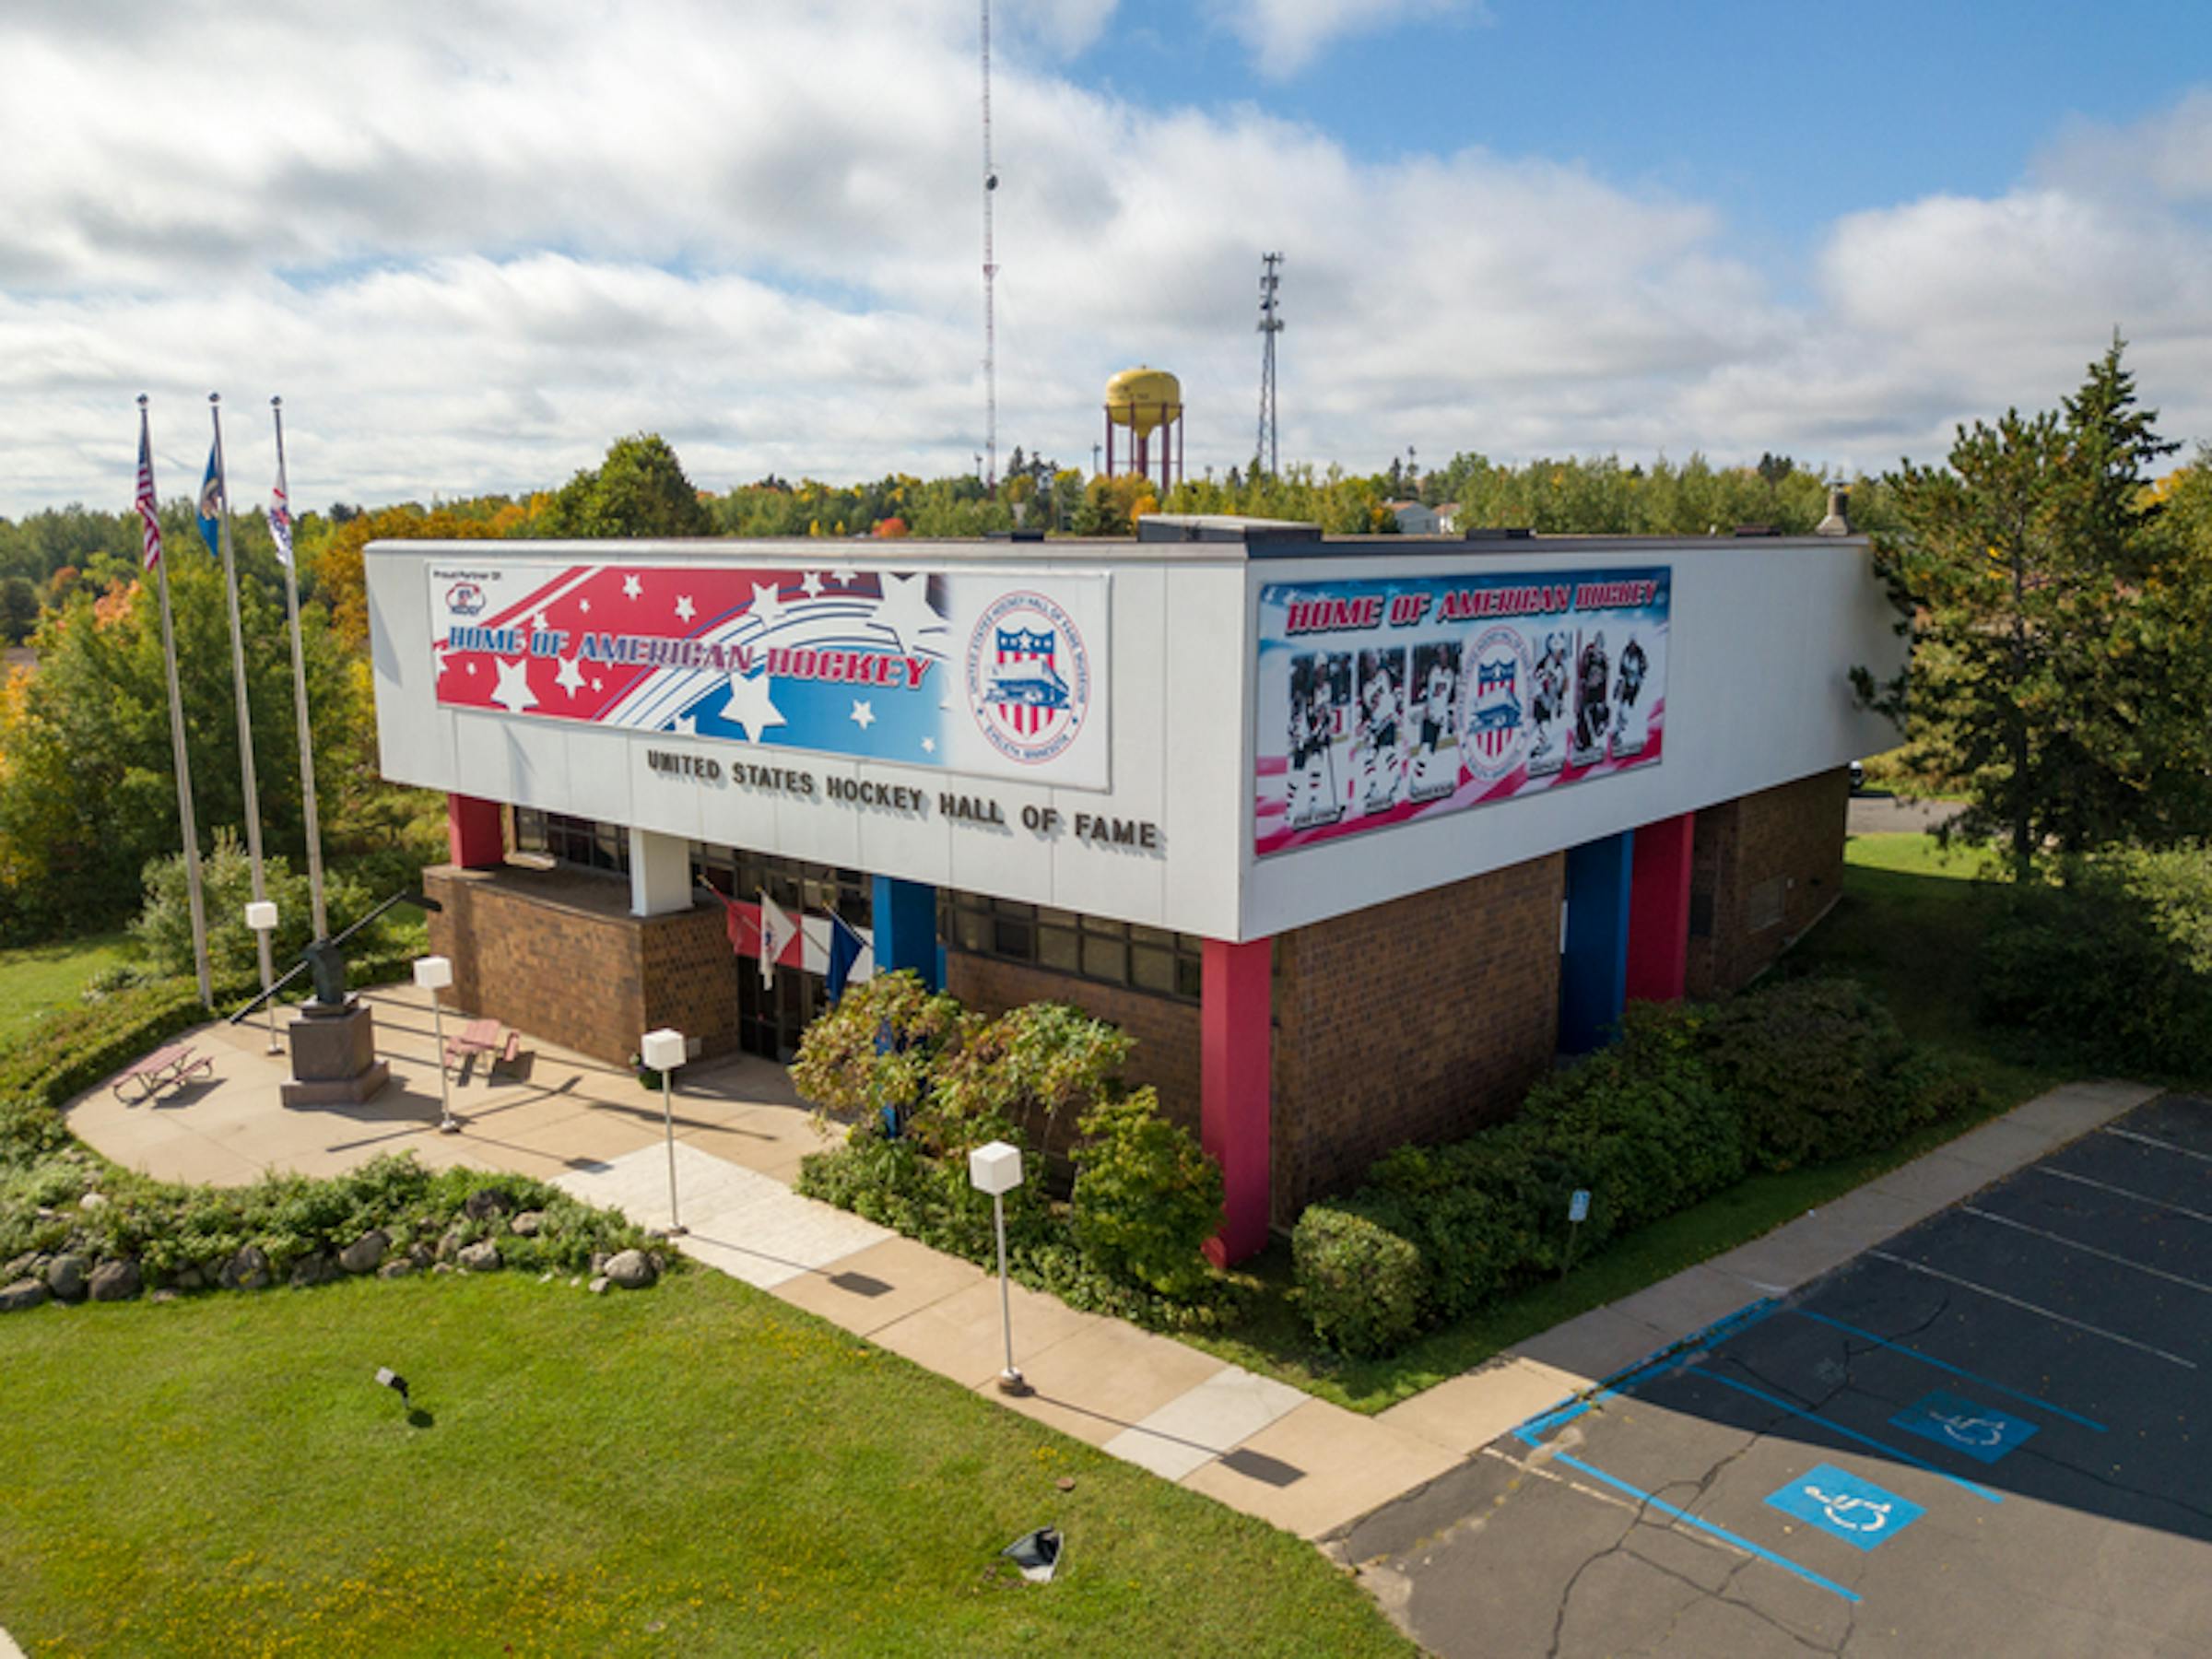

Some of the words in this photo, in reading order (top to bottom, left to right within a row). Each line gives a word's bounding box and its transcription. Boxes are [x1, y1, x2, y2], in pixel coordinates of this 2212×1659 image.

[1286, 595, 1383, 636] HOME
[1389, 592, 1430, 627] OF
[1436, 584, 1571, 623] AMERICAN
[1573, 580, 1657, 611] HOCKEY
[449, 626, 526, 656] HOME
[531, 630, 569, 658] OF
[575, 633, 754, 674] AMERICAN
[764, 645, 934, 690] HOCKEY
[648, 749, 720, 780] UNITED
[732, 761, 813, 794] STATES
[826, 775, 922, 811] HOCKEY
[939, 792, 1005, 825] HALL
[1021, 805, 1058, 832] OF
[1074, 813, 1157, 849] FAME
